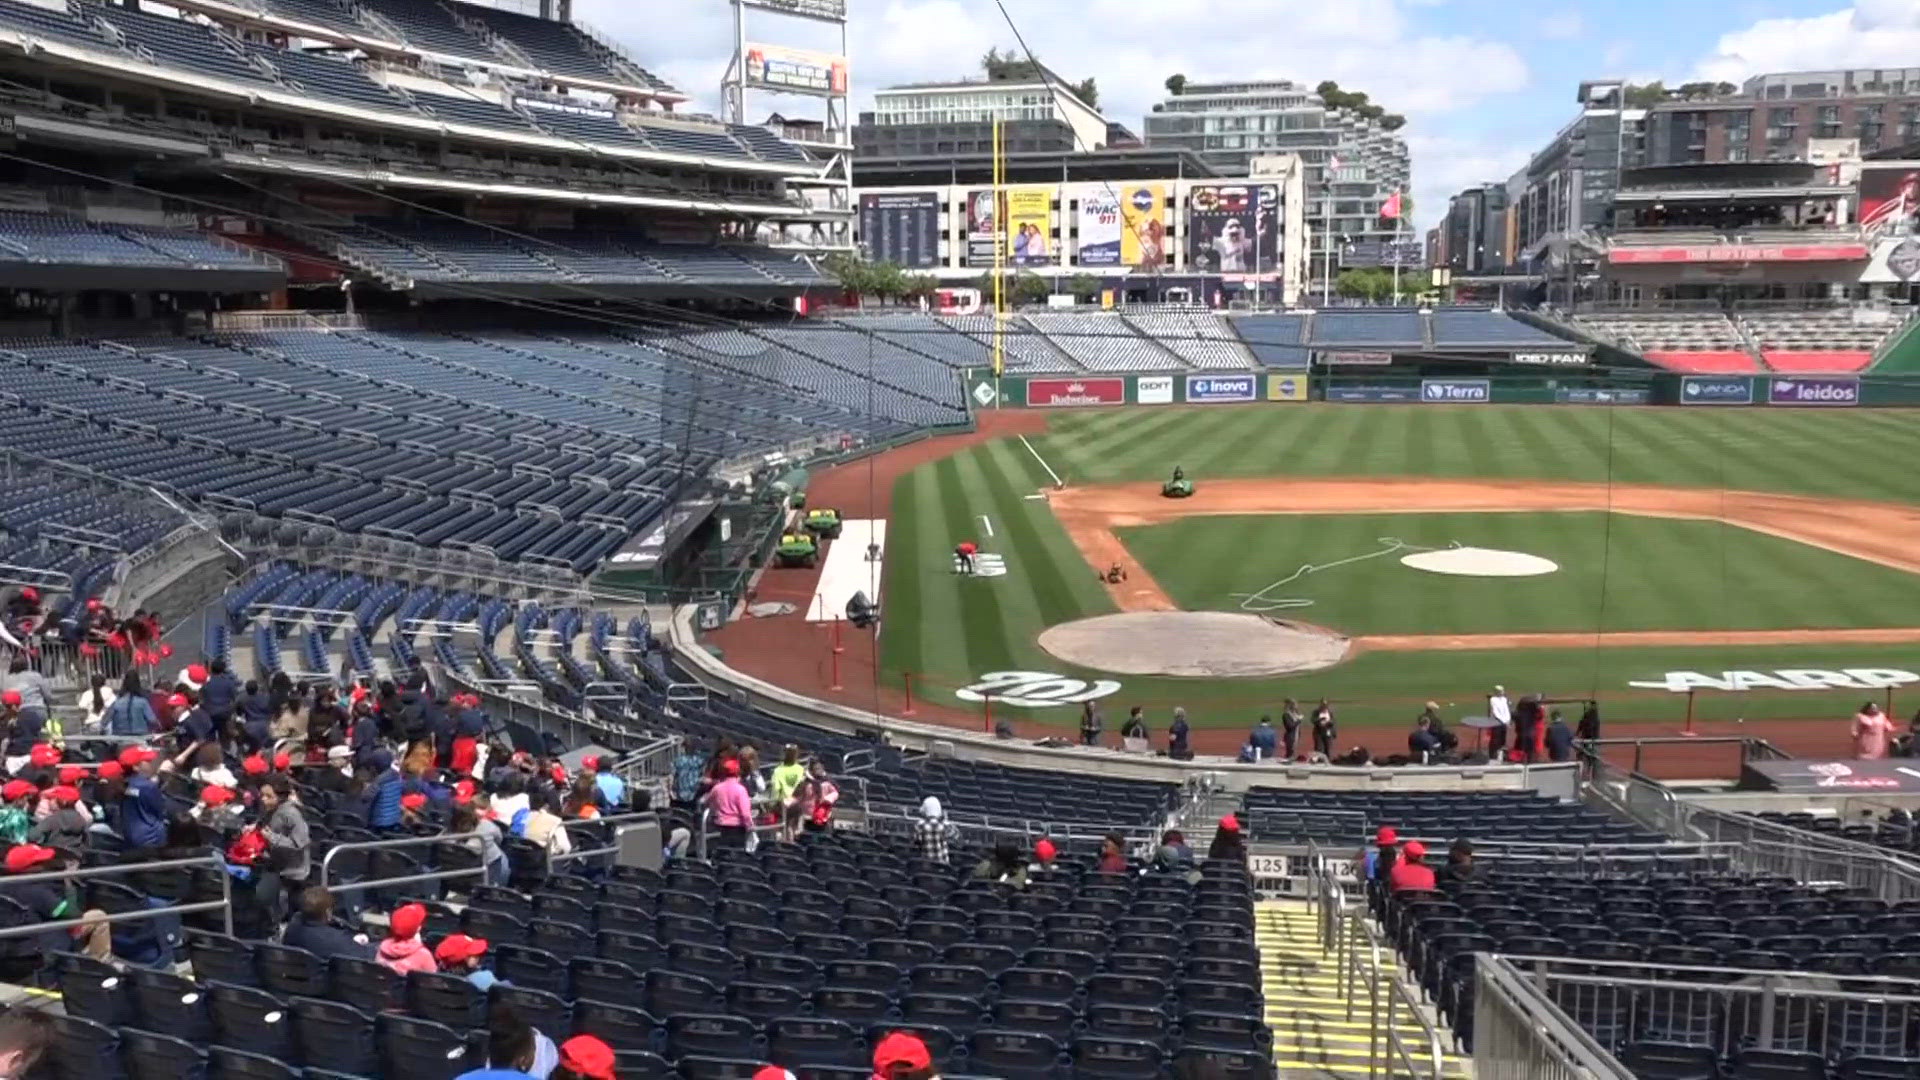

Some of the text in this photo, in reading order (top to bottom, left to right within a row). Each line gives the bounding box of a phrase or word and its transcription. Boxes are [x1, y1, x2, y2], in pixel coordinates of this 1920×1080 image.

[1086, 205, 1118, 215] HVAC
[1099, 215, 1116, 224] 911
[1551, 353, 1586, 363] FAN
[1140, 381, 1170, 390] GDIT
[1444, 384, 1484, 399] Terra
[1797, 384, 1855, 400] leidos
[1050, 394, 1100, 404] Budweiser
[1254, 858, 1283, 873] 125
